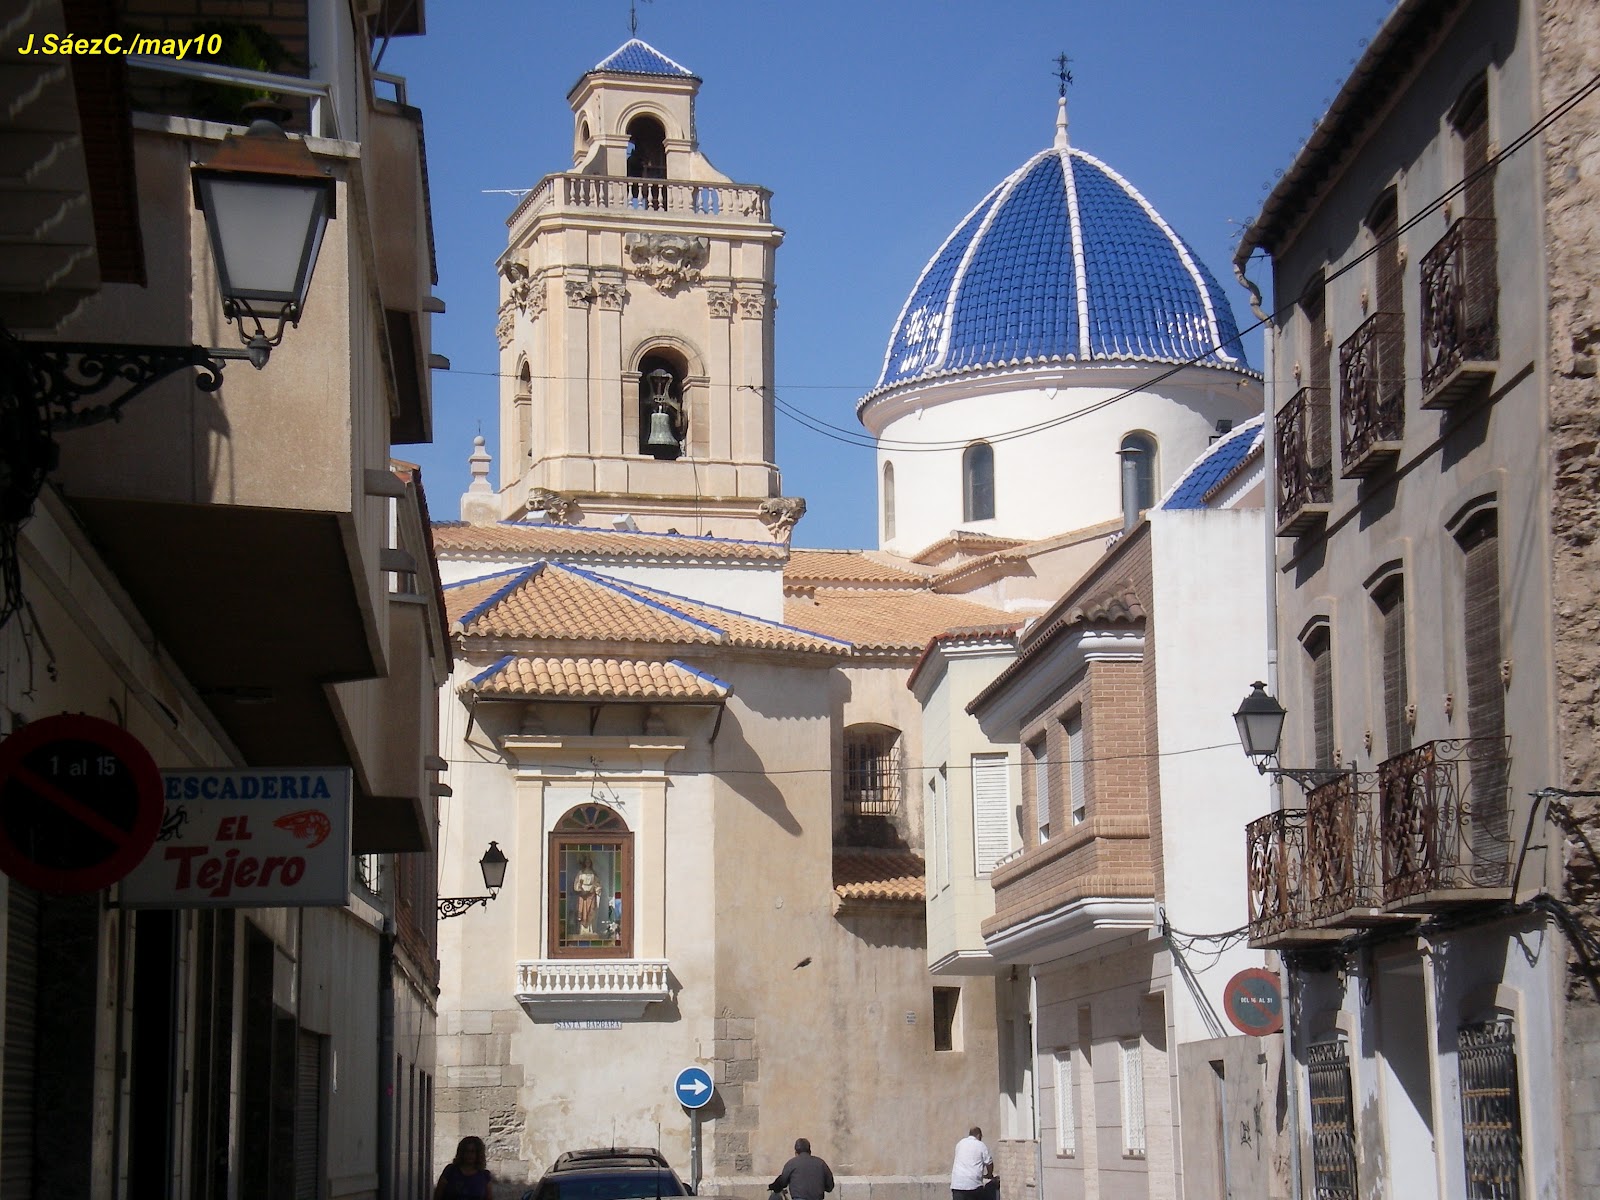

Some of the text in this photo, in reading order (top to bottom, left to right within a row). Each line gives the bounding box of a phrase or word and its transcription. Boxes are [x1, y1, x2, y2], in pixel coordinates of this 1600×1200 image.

[50, 756, 116, 776] 1 al 15
[165, 776, 331, 800] ESCADERIA
[215, 815, 253, 841] EL
[164, 846, 306, 897] Tejero
